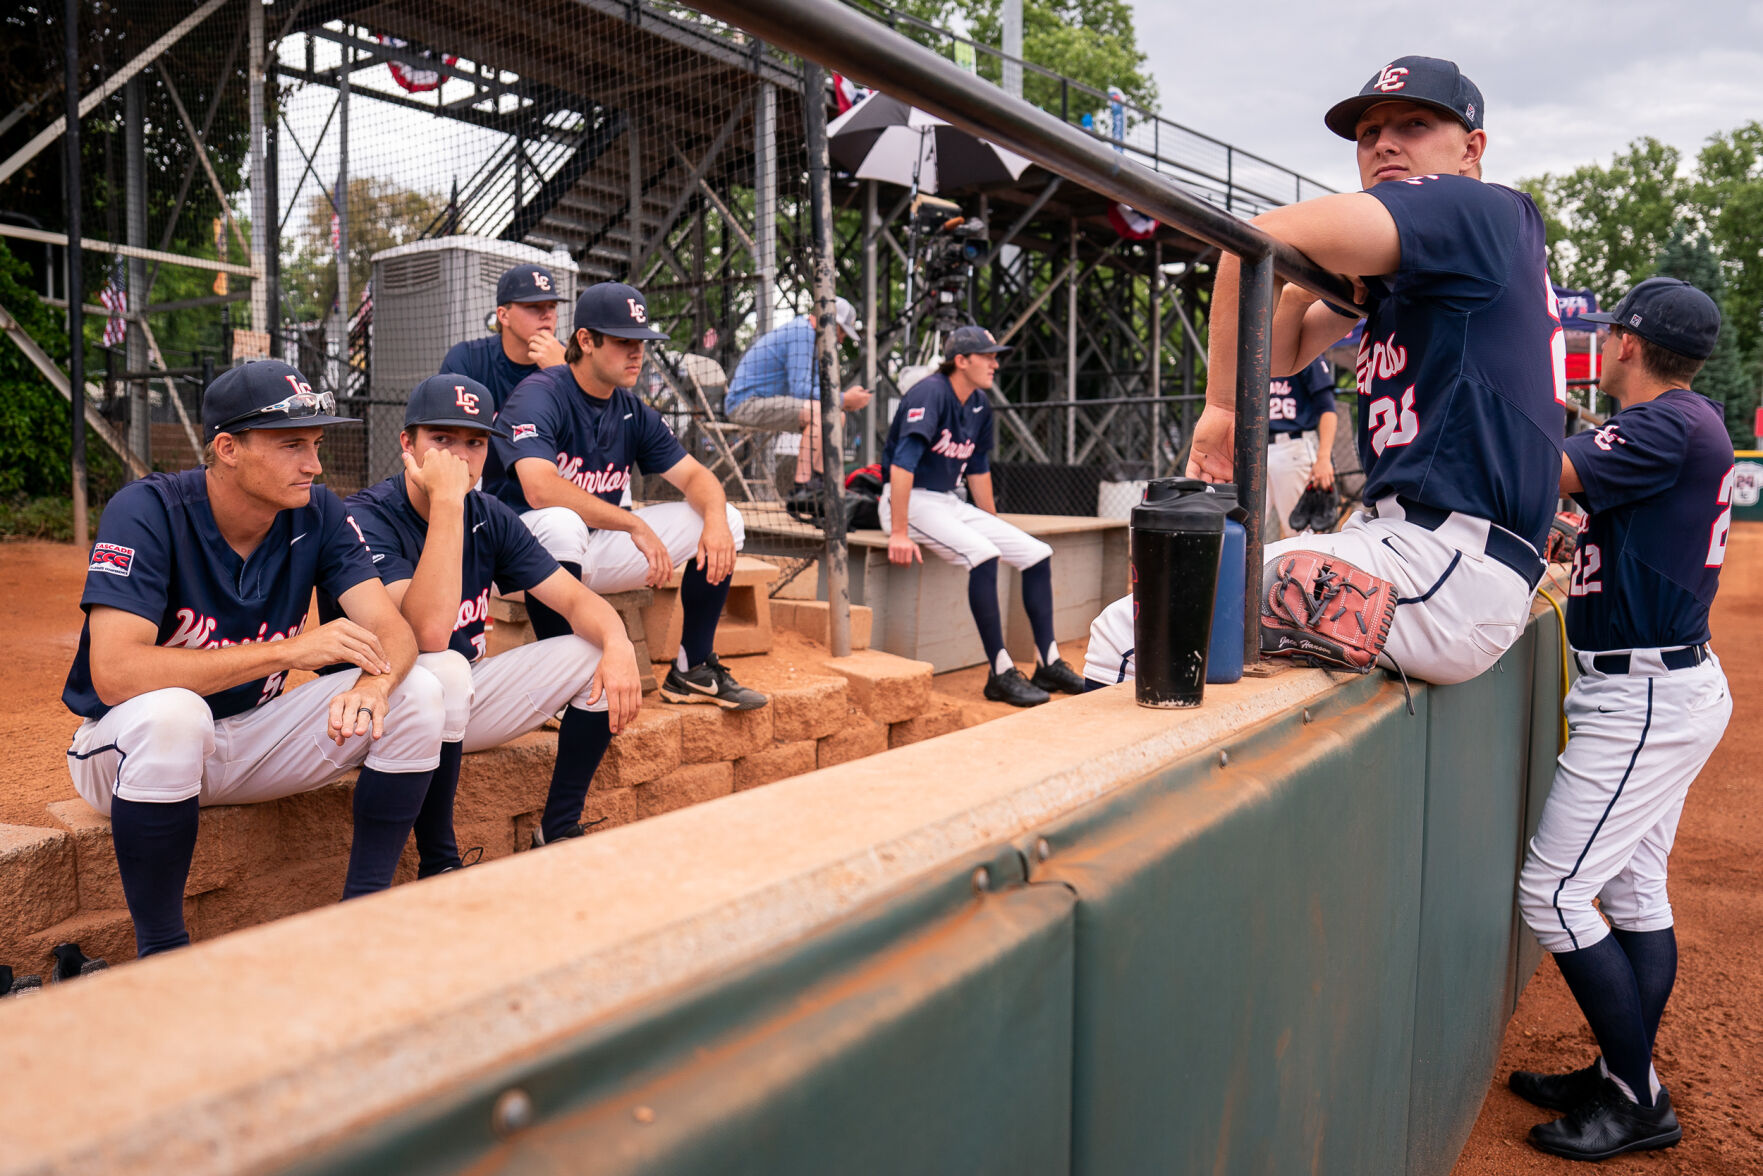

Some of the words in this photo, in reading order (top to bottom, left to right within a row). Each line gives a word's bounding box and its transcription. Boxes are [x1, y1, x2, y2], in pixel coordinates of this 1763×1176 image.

[1373, 64, 1410, 93] LC
[532, 271, 551, 291] LC
[627, 298, 647, 324] LC
[454, 385, 480, 416] LC
[1269, 397, 1297, 420] 26
[93, 551, 130, 567] CCC
[96, 544, 133, 555] CASCADE
